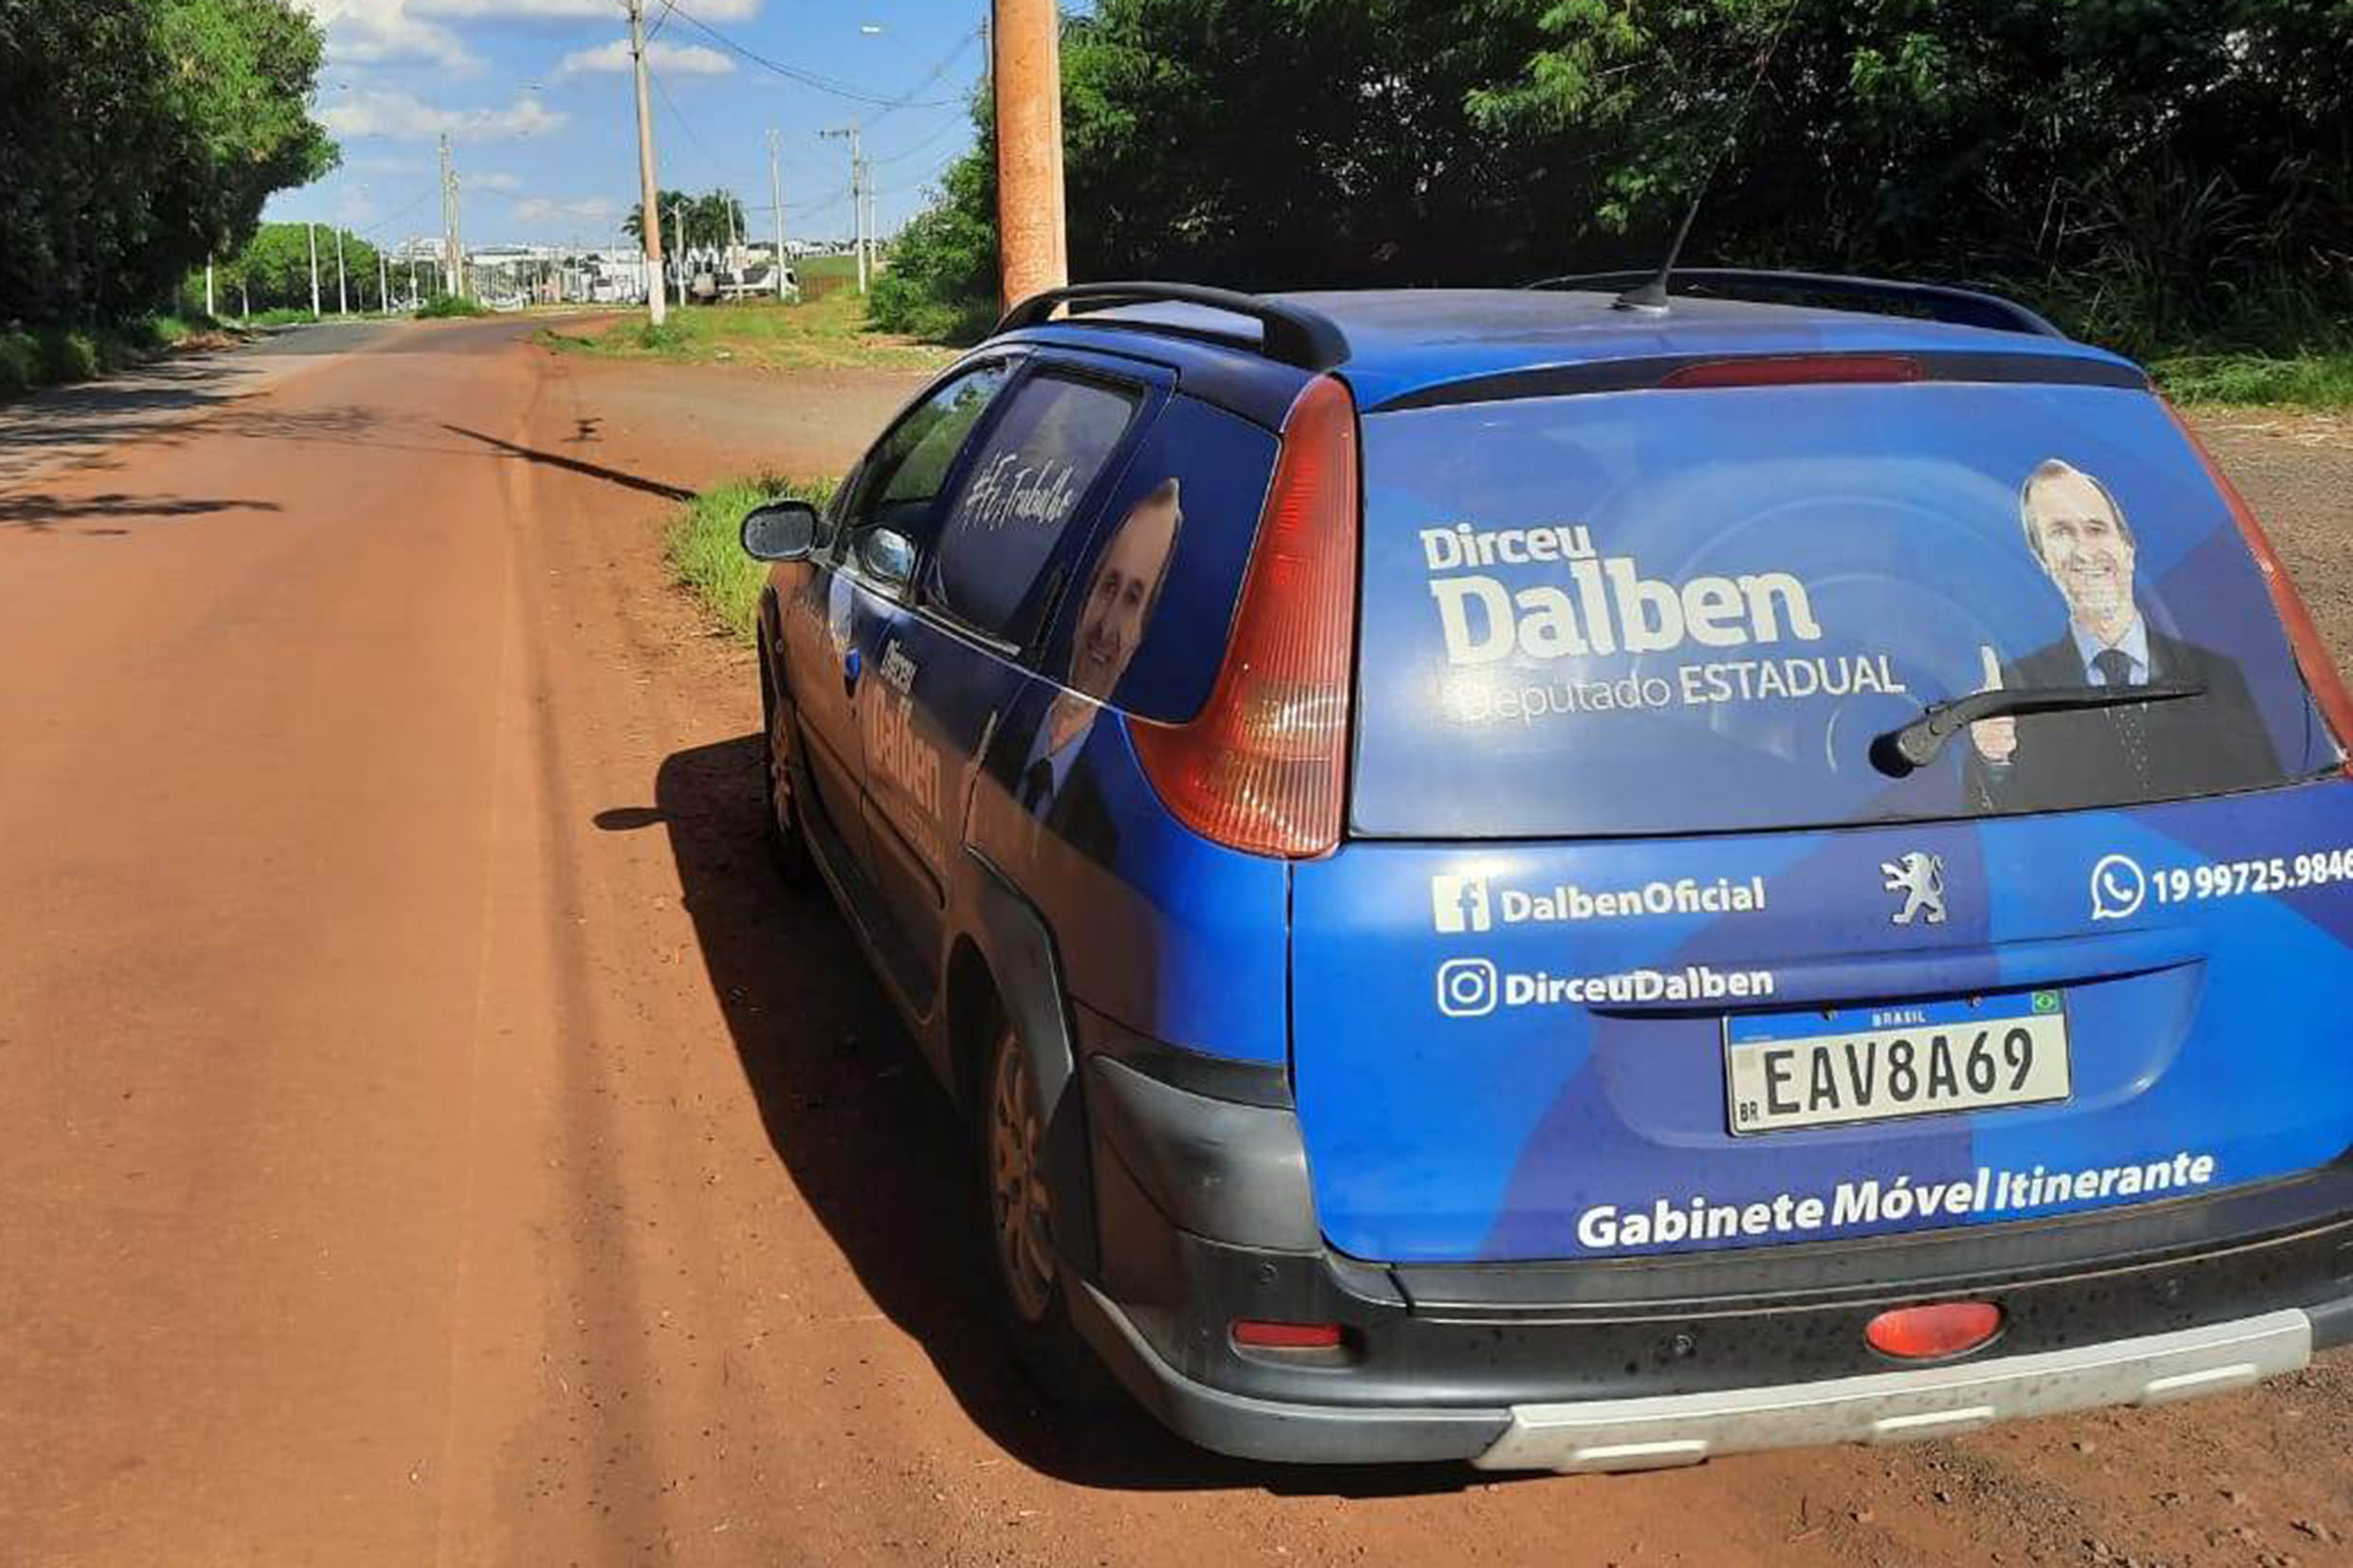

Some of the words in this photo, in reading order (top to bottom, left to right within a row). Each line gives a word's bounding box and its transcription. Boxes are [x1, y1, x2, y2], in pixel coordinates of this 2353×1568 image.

[1420, 524, 1596, 569] Dirceu
[1432, 557, 1821, 665] Dalben
[1679, 655, 1905, 705] ESTADUAL
[1502, 876, 1766, 923] DalbenOficial
[1506, 968, 1774, 1005] DirceuDalben
[1872, 1010, 1926, 1026] BRASIL
[1765, 1028, 2034, 1116] EAV8A69
[1739, 1101, 1758, 1121] BR
[1577, 1193, 1824, 1248] Gabinete
[1832, 1167, 1991, 1227] Móvel
[1993, 1152, 2214, 1210] Itinerante
